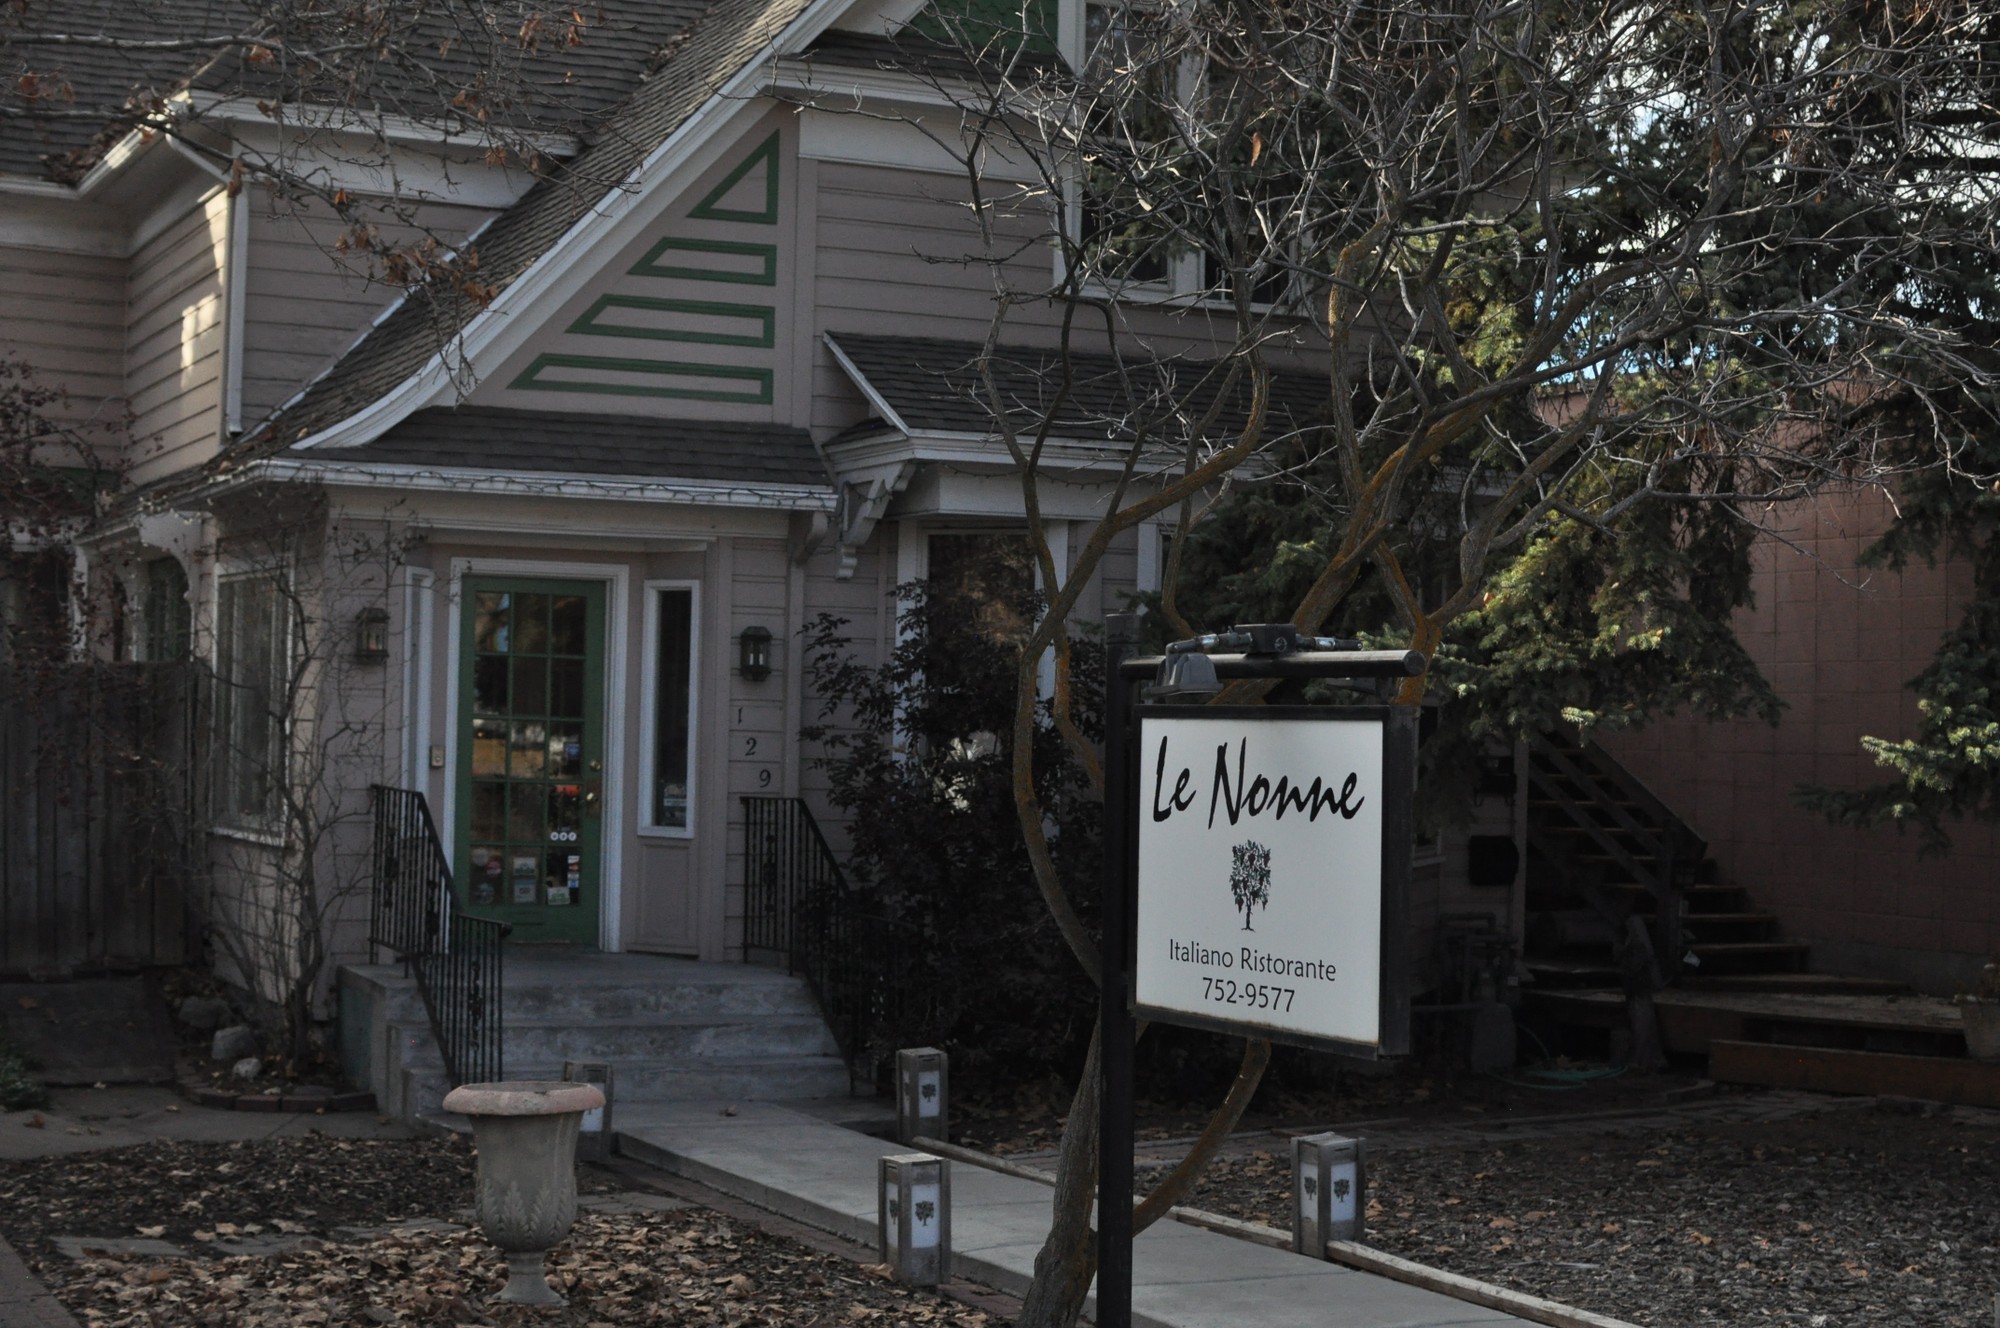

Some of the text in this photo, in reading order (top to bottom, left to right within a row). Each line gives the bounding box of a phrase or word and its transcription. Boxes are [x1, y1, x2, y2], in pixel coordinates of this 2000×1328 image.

[744, 736, 757, 757] 2
[759, 767, 772, 789] 9
[1152, 734, 1365, 830] Le Nonne
[1169, 938, 1337, 982] Italiano Ristorante
[1202, 975, 1296, 1013] 752-9577
